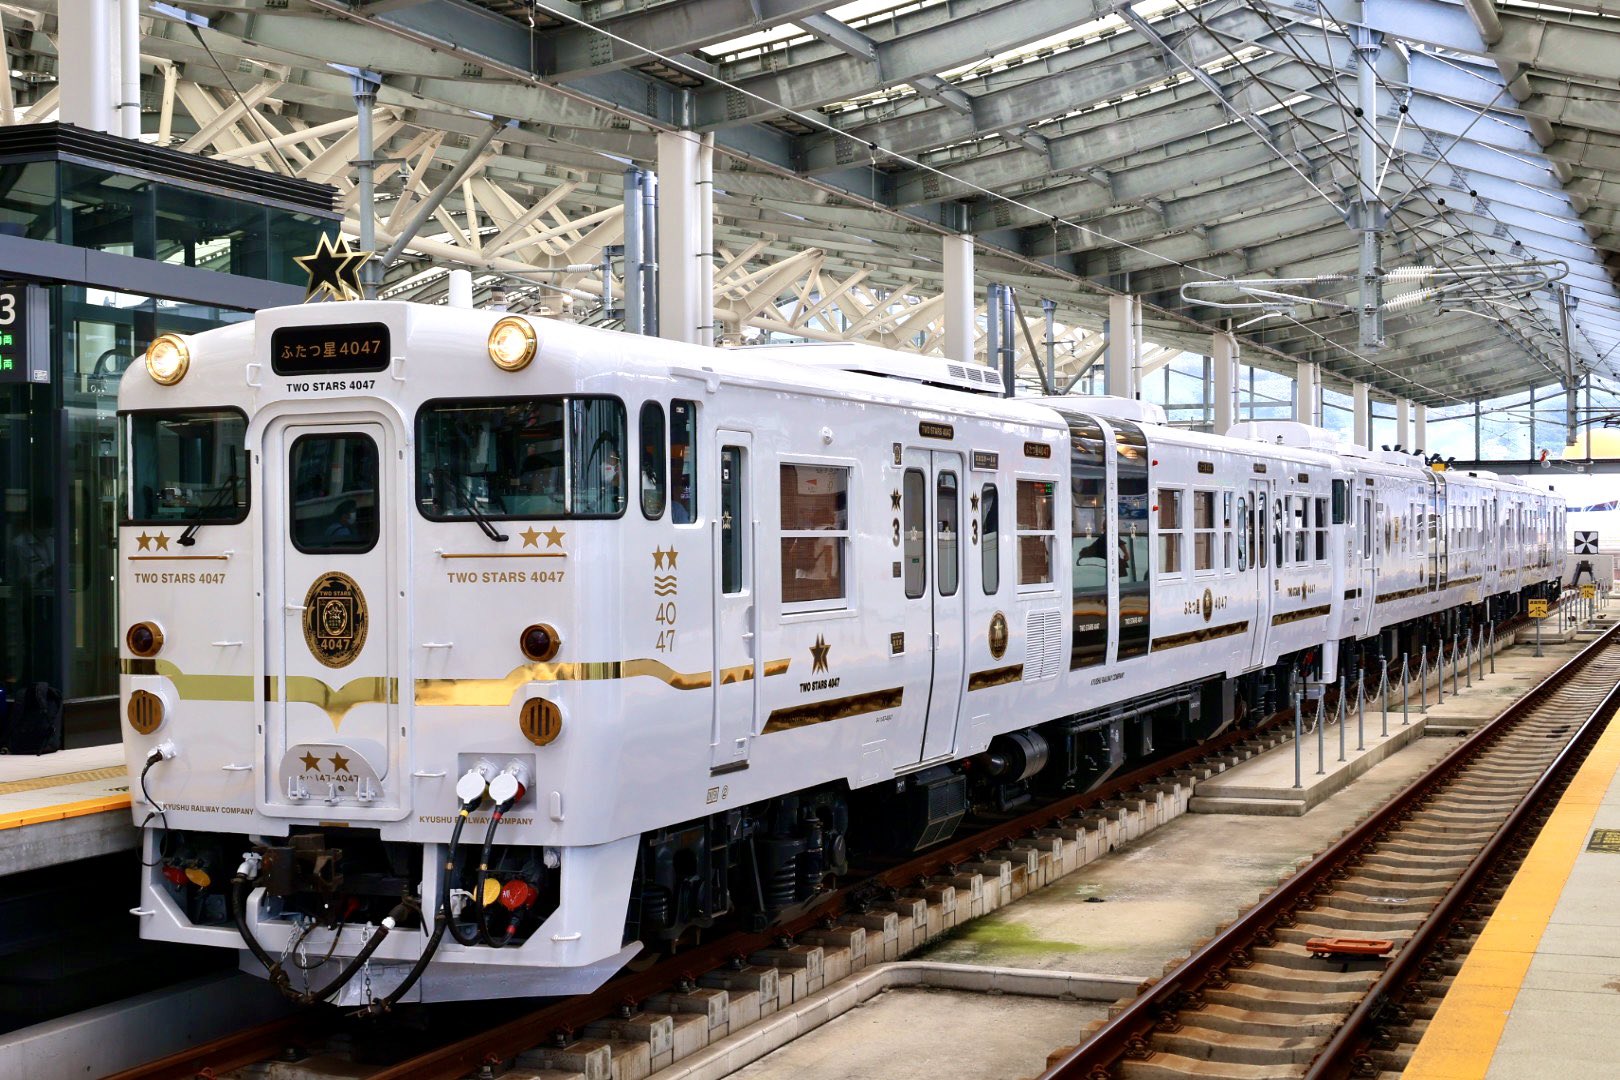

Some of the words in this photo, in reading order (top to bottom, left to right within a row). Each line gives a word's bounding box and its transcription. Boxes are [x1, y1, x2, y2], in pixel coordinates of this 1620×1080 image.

[281, 340, 381, 359] ふたつ星4047
[286, 383, 309, 392] TWO
[312, 381, 346, 391] STARS
[349, 380, 376, 390] 4047
[892, 517, 900, 547] 3
[972, 518, 978, 545] 3
[135, 573, 158, 583] TWO
[161, 573, 196, 583] STARS
[199, 573, 226, 584] 4047
[447, 572, 478, 583] TWO
[482, 571, 526, 583] STARS
[530, 571, 565, 583] 4047
[655, 601, 676, 625] 40
[321, 639, 351, 650] 4047
[655, 629, 675, 653] 47
[800, 682, 811, 693] TWO
[811, 680, 828, 691] STARS
[828, 677, 840, 688] 4047
[163, 803, 190, 812] KYUSHU
[190, 805, 220, 813] RAILWAY
[221, 806, 254, 815] COMPANY
[419, 815, 452, 824] KYUSHU
[496, 816, 534, 825] OMPANY
